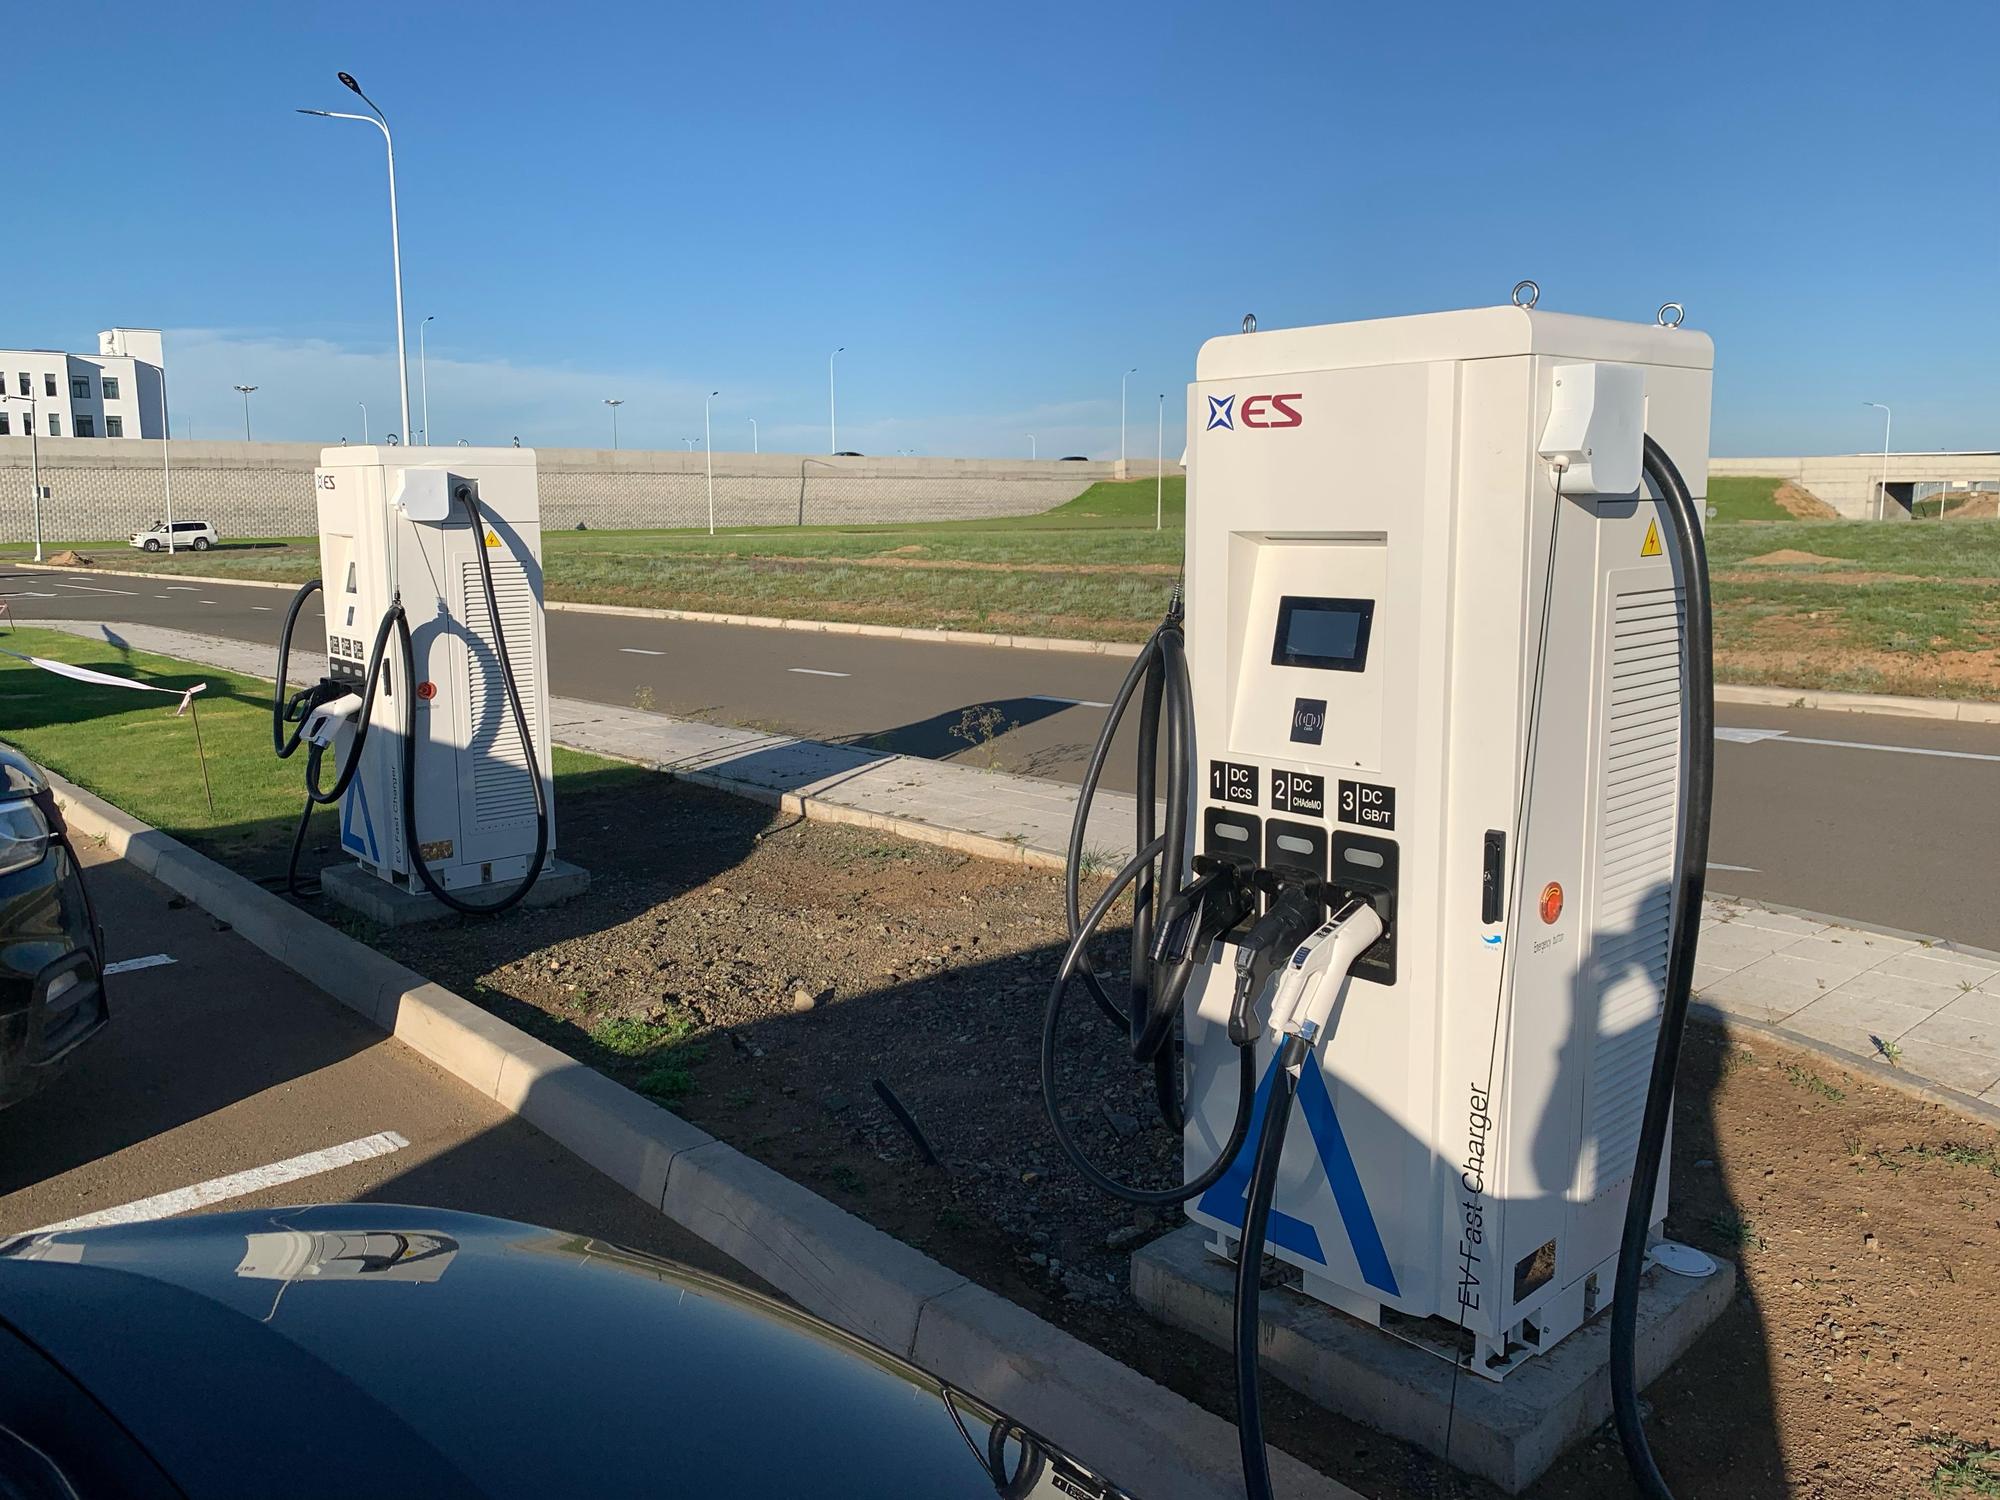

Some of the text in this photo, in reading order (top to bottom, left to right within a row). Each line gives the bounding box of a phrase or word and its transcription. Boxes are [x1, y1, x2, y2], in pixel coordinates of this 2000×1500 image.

[1241, 393, 1303, 428] ES
[1213, 770, 1220, 788] 1
[1231, 768, 1249, 782] DC
[1230, 786, 1252, 799] CCS
[1275, 779, 1285, 799] 2
[1293, 777, 1312, 793] DC
[1292, 796, 1321, 810] CHAdeMO
[1342, 790, 1354, 811] 3
[1362, 788, 1382, 804] DC
[1362, 808, 1391, 823] GB/T
[1458, 1082, 1492, 1311] EV Fast Charger
